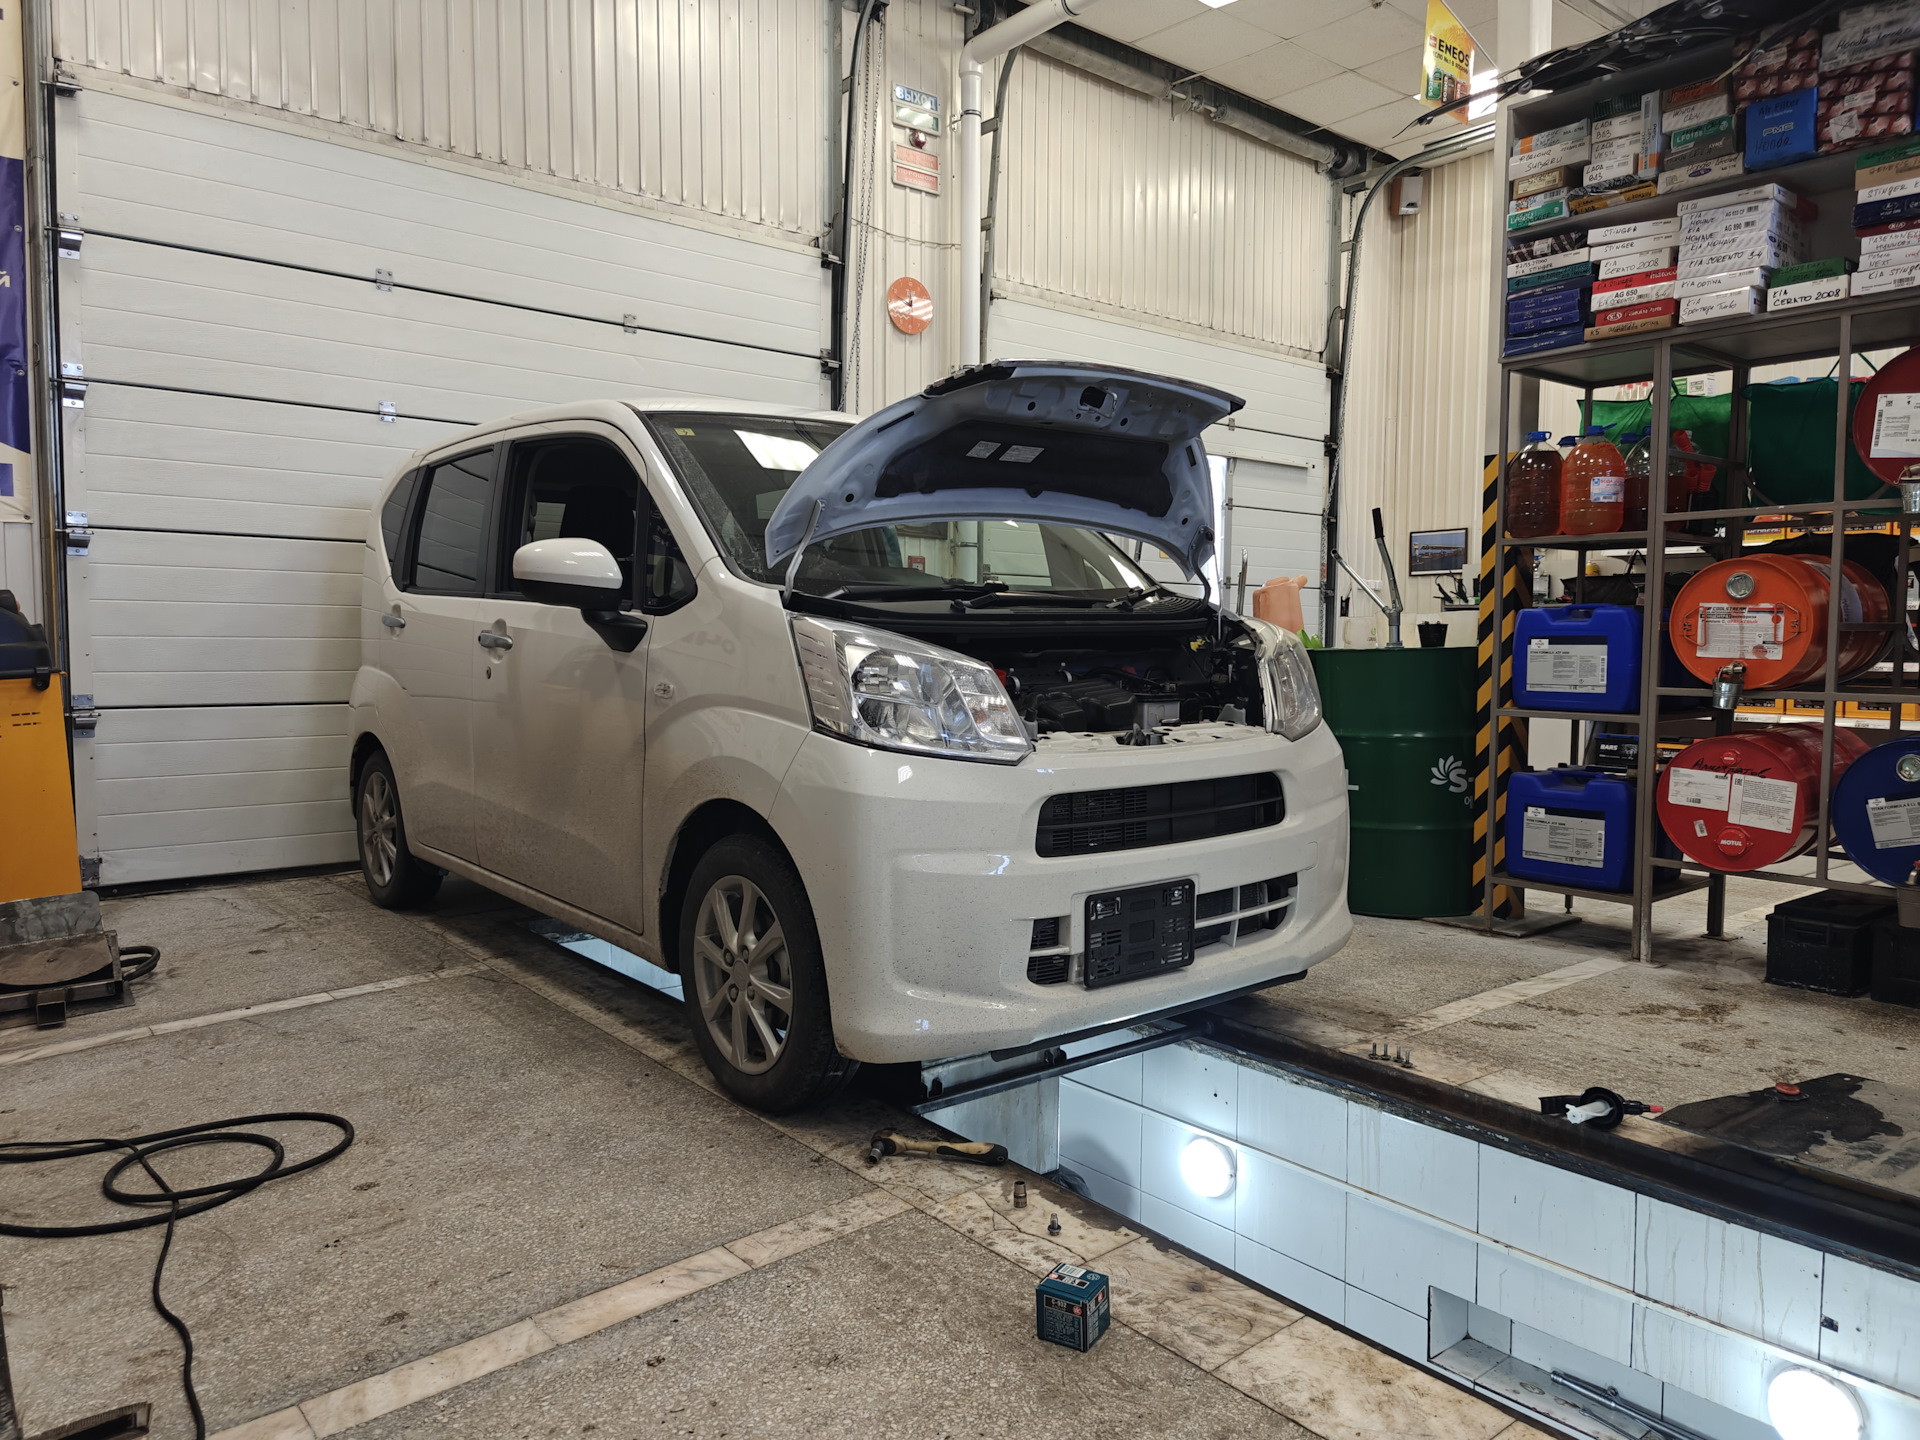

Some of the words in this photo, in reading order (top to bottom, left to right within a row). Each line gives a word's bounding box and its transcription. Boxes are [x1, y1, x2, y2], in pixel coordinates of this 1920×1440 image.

[1438, 38, 1470, 67] ENEOS
[895, 85, 937, 111] ВЫХОД
[1754, 132, 1793, 155] Honda
[1724, 224, 1732, 232] AG
[1706, 251, 1744, 265] SORENTO
[1604, 264, 1636, 276] CERATO
[1636, 257, 1660, 270] 2008
[1614, 291, 1625, 299] AG
[1626, 288, 1638, 297] 650
[1773, 289, 1789, 299] KIA
[1773, 295, 1812, 307] CERATO
[1814, 288, 1841, 301] 2008
[1600, 743, 1618, 751] BARS
[1720, 839, 1743, 847] MOTUL
